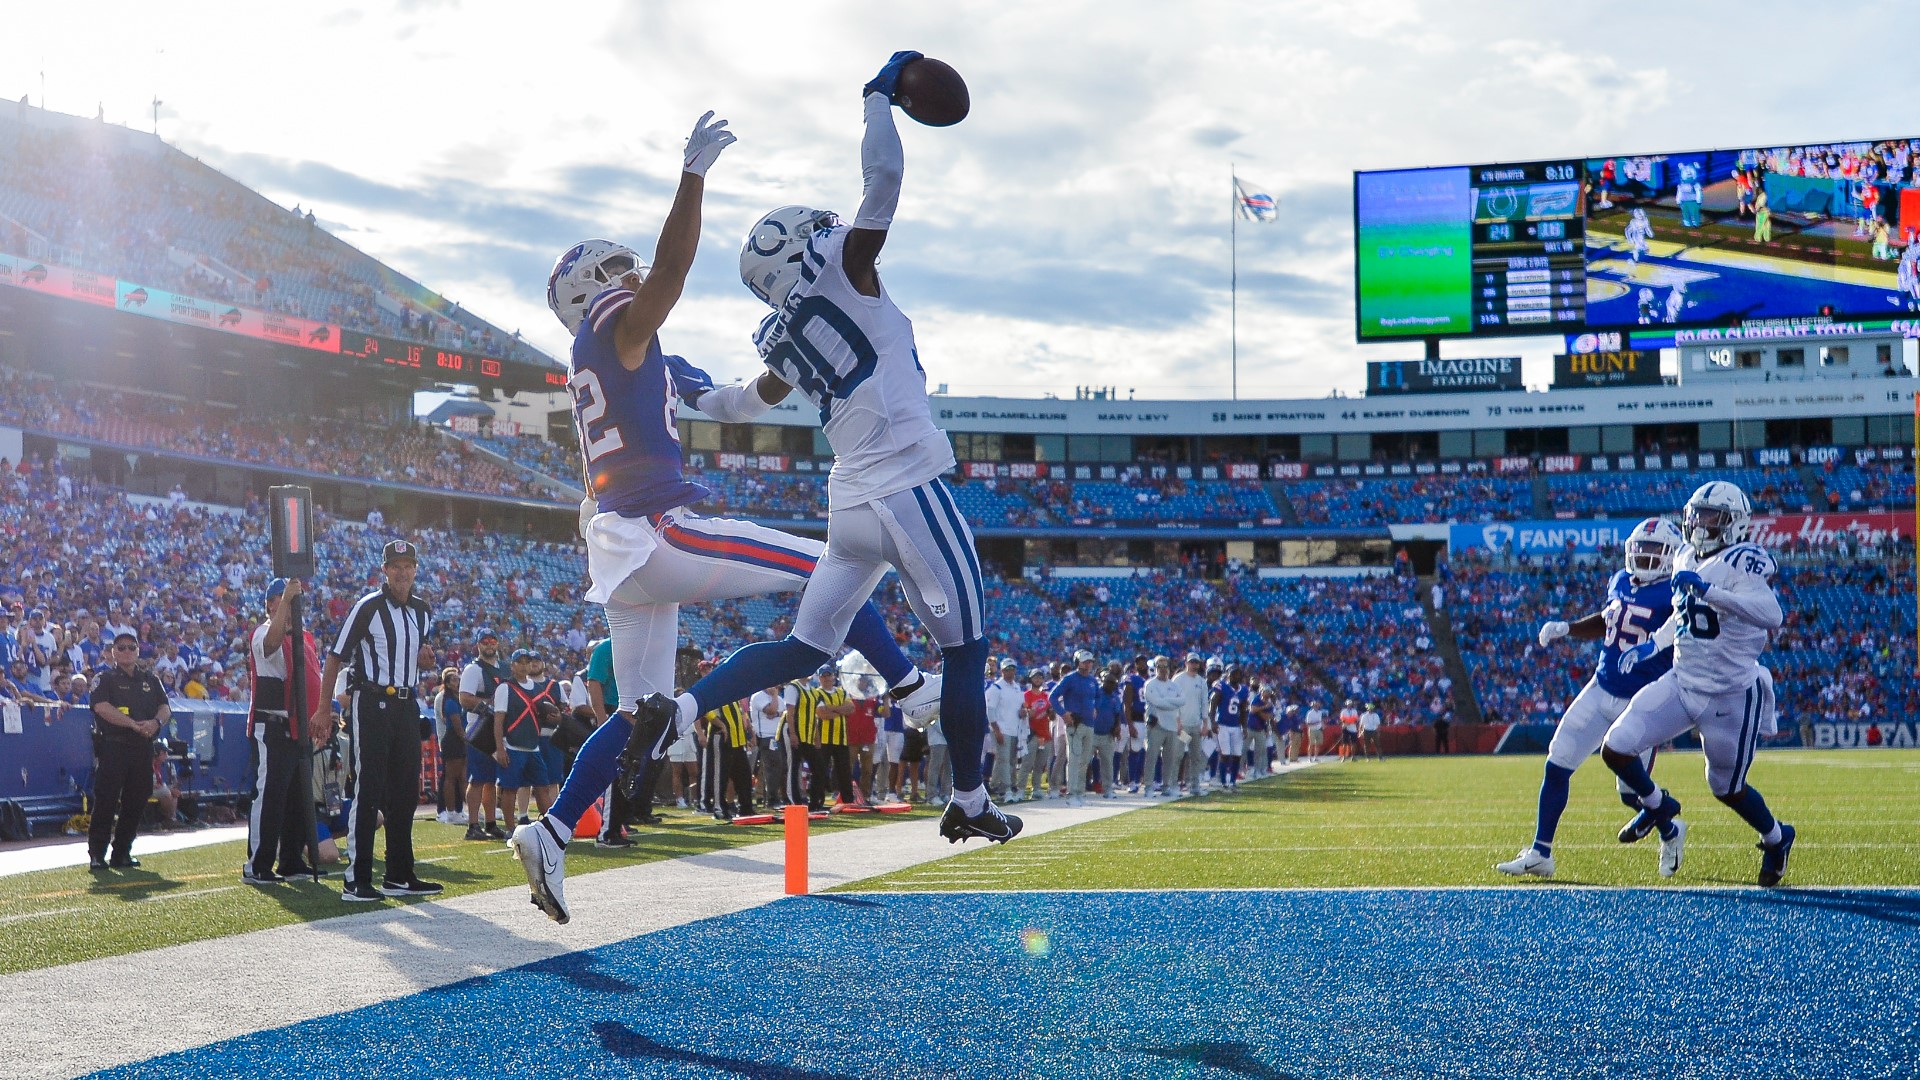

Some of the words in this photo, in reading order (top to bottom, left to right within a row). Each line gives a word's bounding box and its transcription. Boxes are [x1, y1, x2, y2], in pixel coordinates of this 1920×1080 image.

[1545, 165, 1574, 181] 8:10
[170, 302, 211, 321] SPORTSBOOK
[364, 337, 378, 355] 24
[407, 345, 420, 362] 16
[437, 351, 462, 370] 8:10
[764, 294, 878, 428] 30
[1419, 357, 1512, 375] IMAGINE
[1570, 351, 1641, 374] HUNT
[1709, 348, 1732, 368] 40
[1432, 374, 1496, 387] STAFFING
[1098, 413, 1133, 421] MARV
[1138, 413, 1169, 421] LEVY
[1233, 412, 1262, 421] MIKE
[1267, 411, 1325, 421] STRATTON
[1508, 406, 1533, 414] TOM
[719, 453, 746, 470] 240
[758, 455, 781, 472] 241
[1760, 448, 1789, 465] 244
[971, 463, 996, 477] 241
[288, 497, 299, 554] 1
[1520, 527, 1624, 549] FANDUEL
[1745, 556, 1767, 575] 36
[1227, 692, 1237, 707] 6
